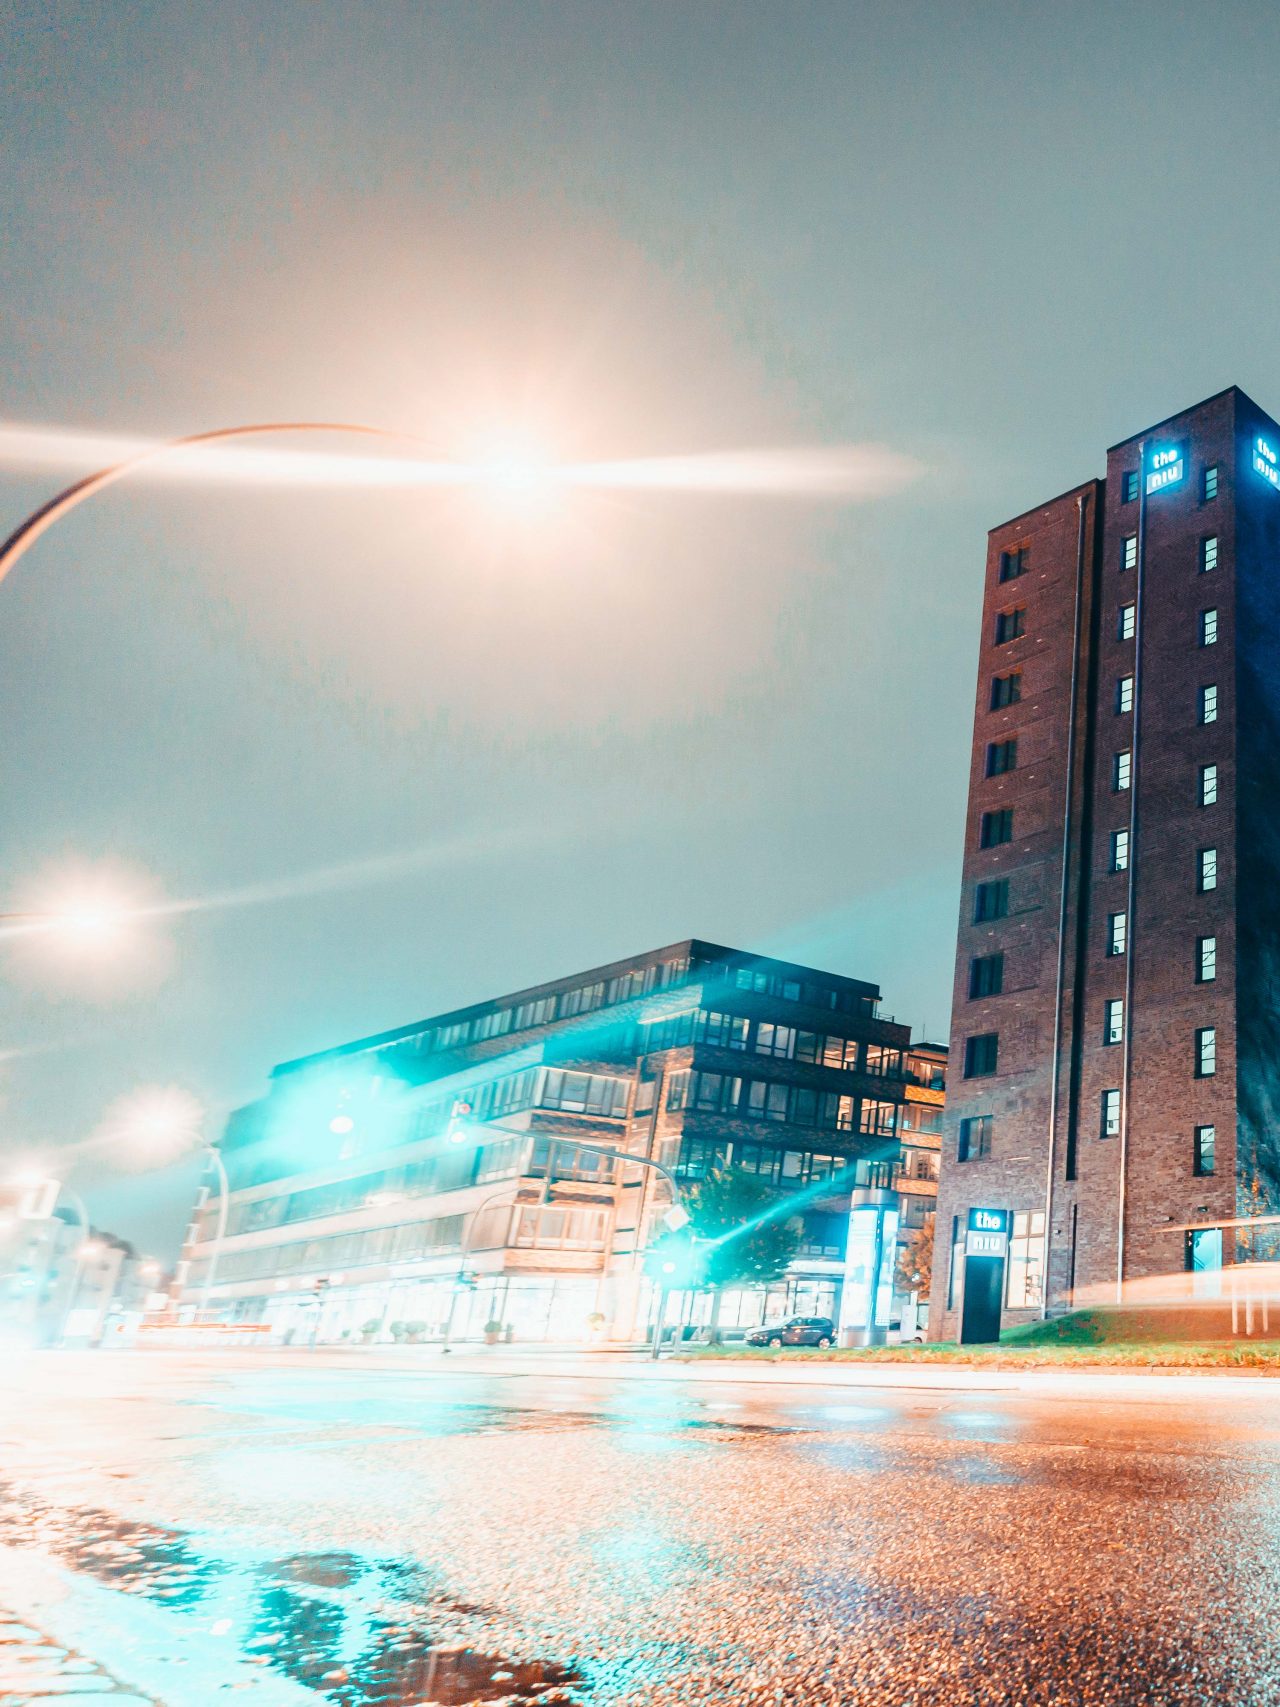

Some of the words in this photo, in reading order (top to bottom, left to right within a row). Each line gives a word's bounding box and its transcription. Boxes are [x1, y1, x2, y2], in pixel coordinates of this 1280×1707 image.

[1153, 450, 1178, 469] the
[1258, 438, 1277, 464] the
[976, 1212, 1001, 1229] the
